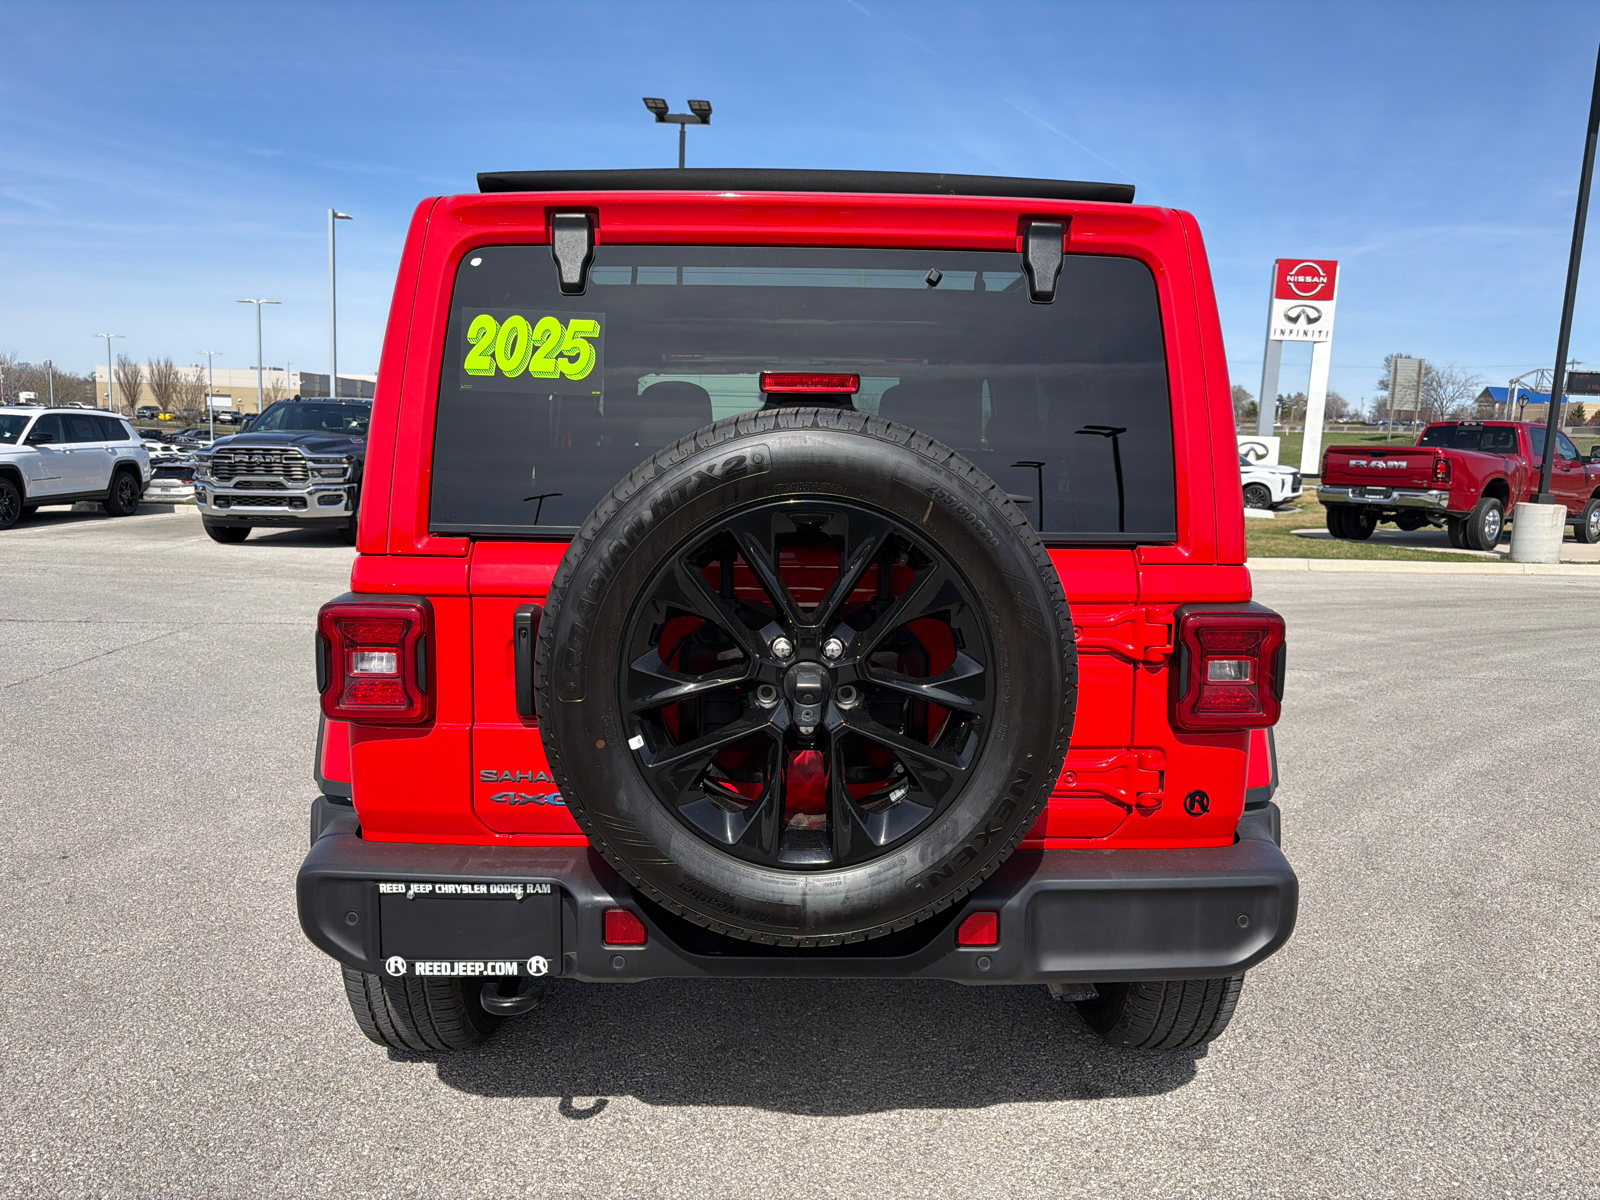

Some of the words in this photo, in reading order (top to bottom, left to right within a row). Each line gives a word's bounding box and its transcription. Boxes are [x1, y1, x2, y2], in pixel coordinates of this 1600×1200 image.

[1286, 275, 1328, 283] NISSAN
[1273, 328, 1330, 338] INFINITI
[464, 314, 601, 381] 2025
[234, 454, 281, 463] RAM
[1349, 459, 1408, 469] RAM
[564, 513, 647, 677] ROADIAN
[649, 455, 747, 520] HTX2
[479, 769, 555, 783] SAHA
[925, 767, 1033, 888] NEXEN
[379, 883, 406, 894] REED
[408, 883, 433, 894] JEEP
[435, 883, 488, 894] CHRYSLER
[489, 883, 524, 894] DODGE
[526, 883, 551, 894] RAM
[415, 961, 518, 975] REEDJEEP.COM
